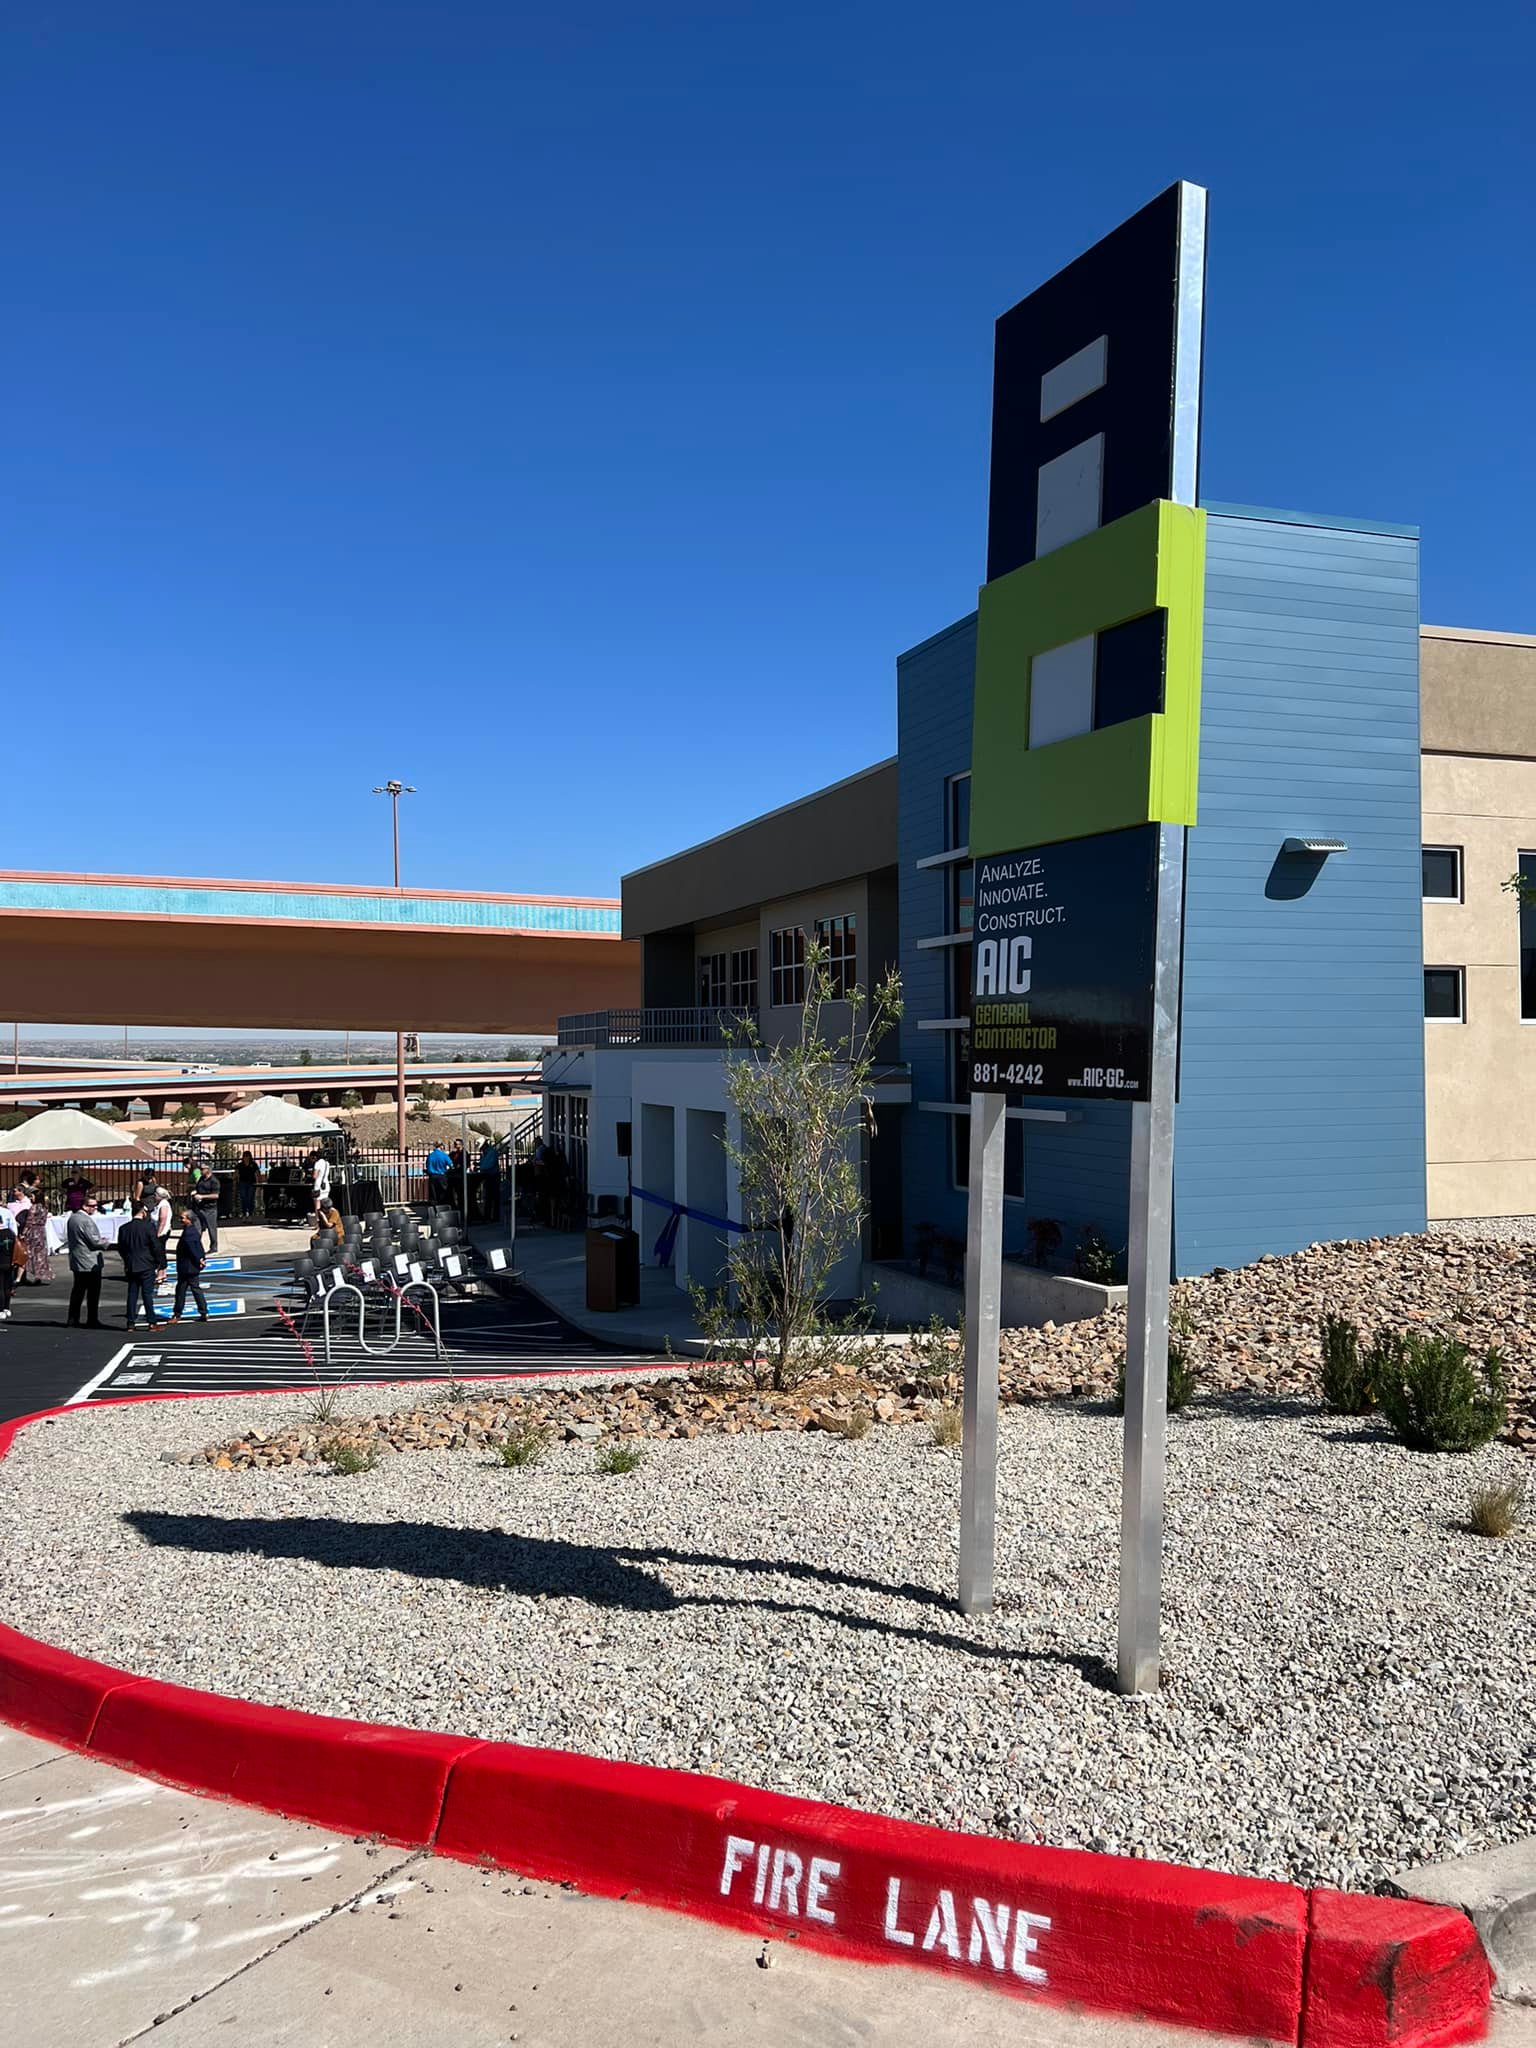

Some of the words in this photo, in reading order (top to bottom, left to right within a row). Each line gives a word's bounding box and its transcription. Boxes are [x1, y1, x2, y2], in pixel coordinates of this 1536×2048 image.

[980, 858, 1045, 884] ANALYZE.
[979, 882, 1048, 907] INNOVATE.
[978, 906, 1066, 932] CONSTRUCT.
[976, 935, 1033, 996] AIC
[975, 1002, 1031, 1025] GENERAL
[974, 1027, 1057, 1049] CONTRACTOR
[973, 1063, 1044, 1085] 881-4242
[720, 1835, 841, 1924] FIRE
[884, 1877, 1051, 1984] LANE
